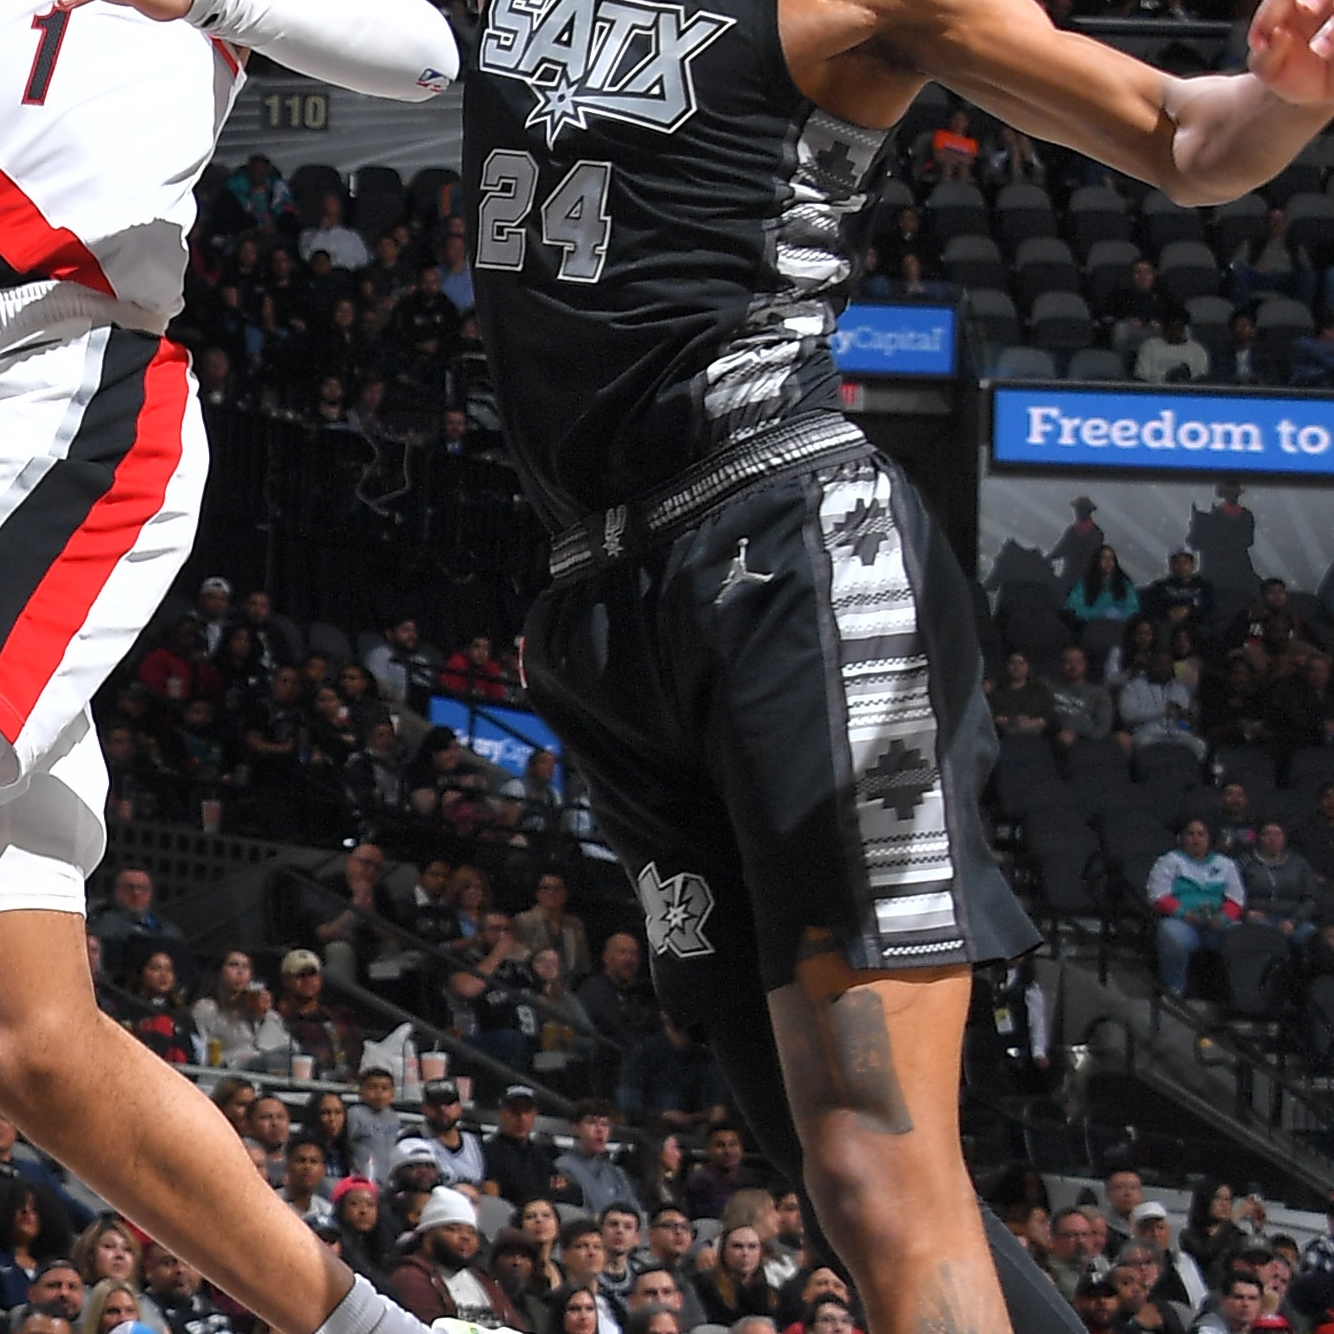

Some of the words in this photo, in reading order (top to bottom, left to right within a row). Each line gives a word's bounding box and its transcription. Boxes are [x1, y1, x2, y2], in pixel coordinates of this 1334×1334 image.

[21, 6, 73, 106] 1
[265, 95, 327, 129] 110
[475, 149, 612, 283] 24
[1026, 406, 1264, 452] Freedom
[1277, 419, 1331, 454] to
